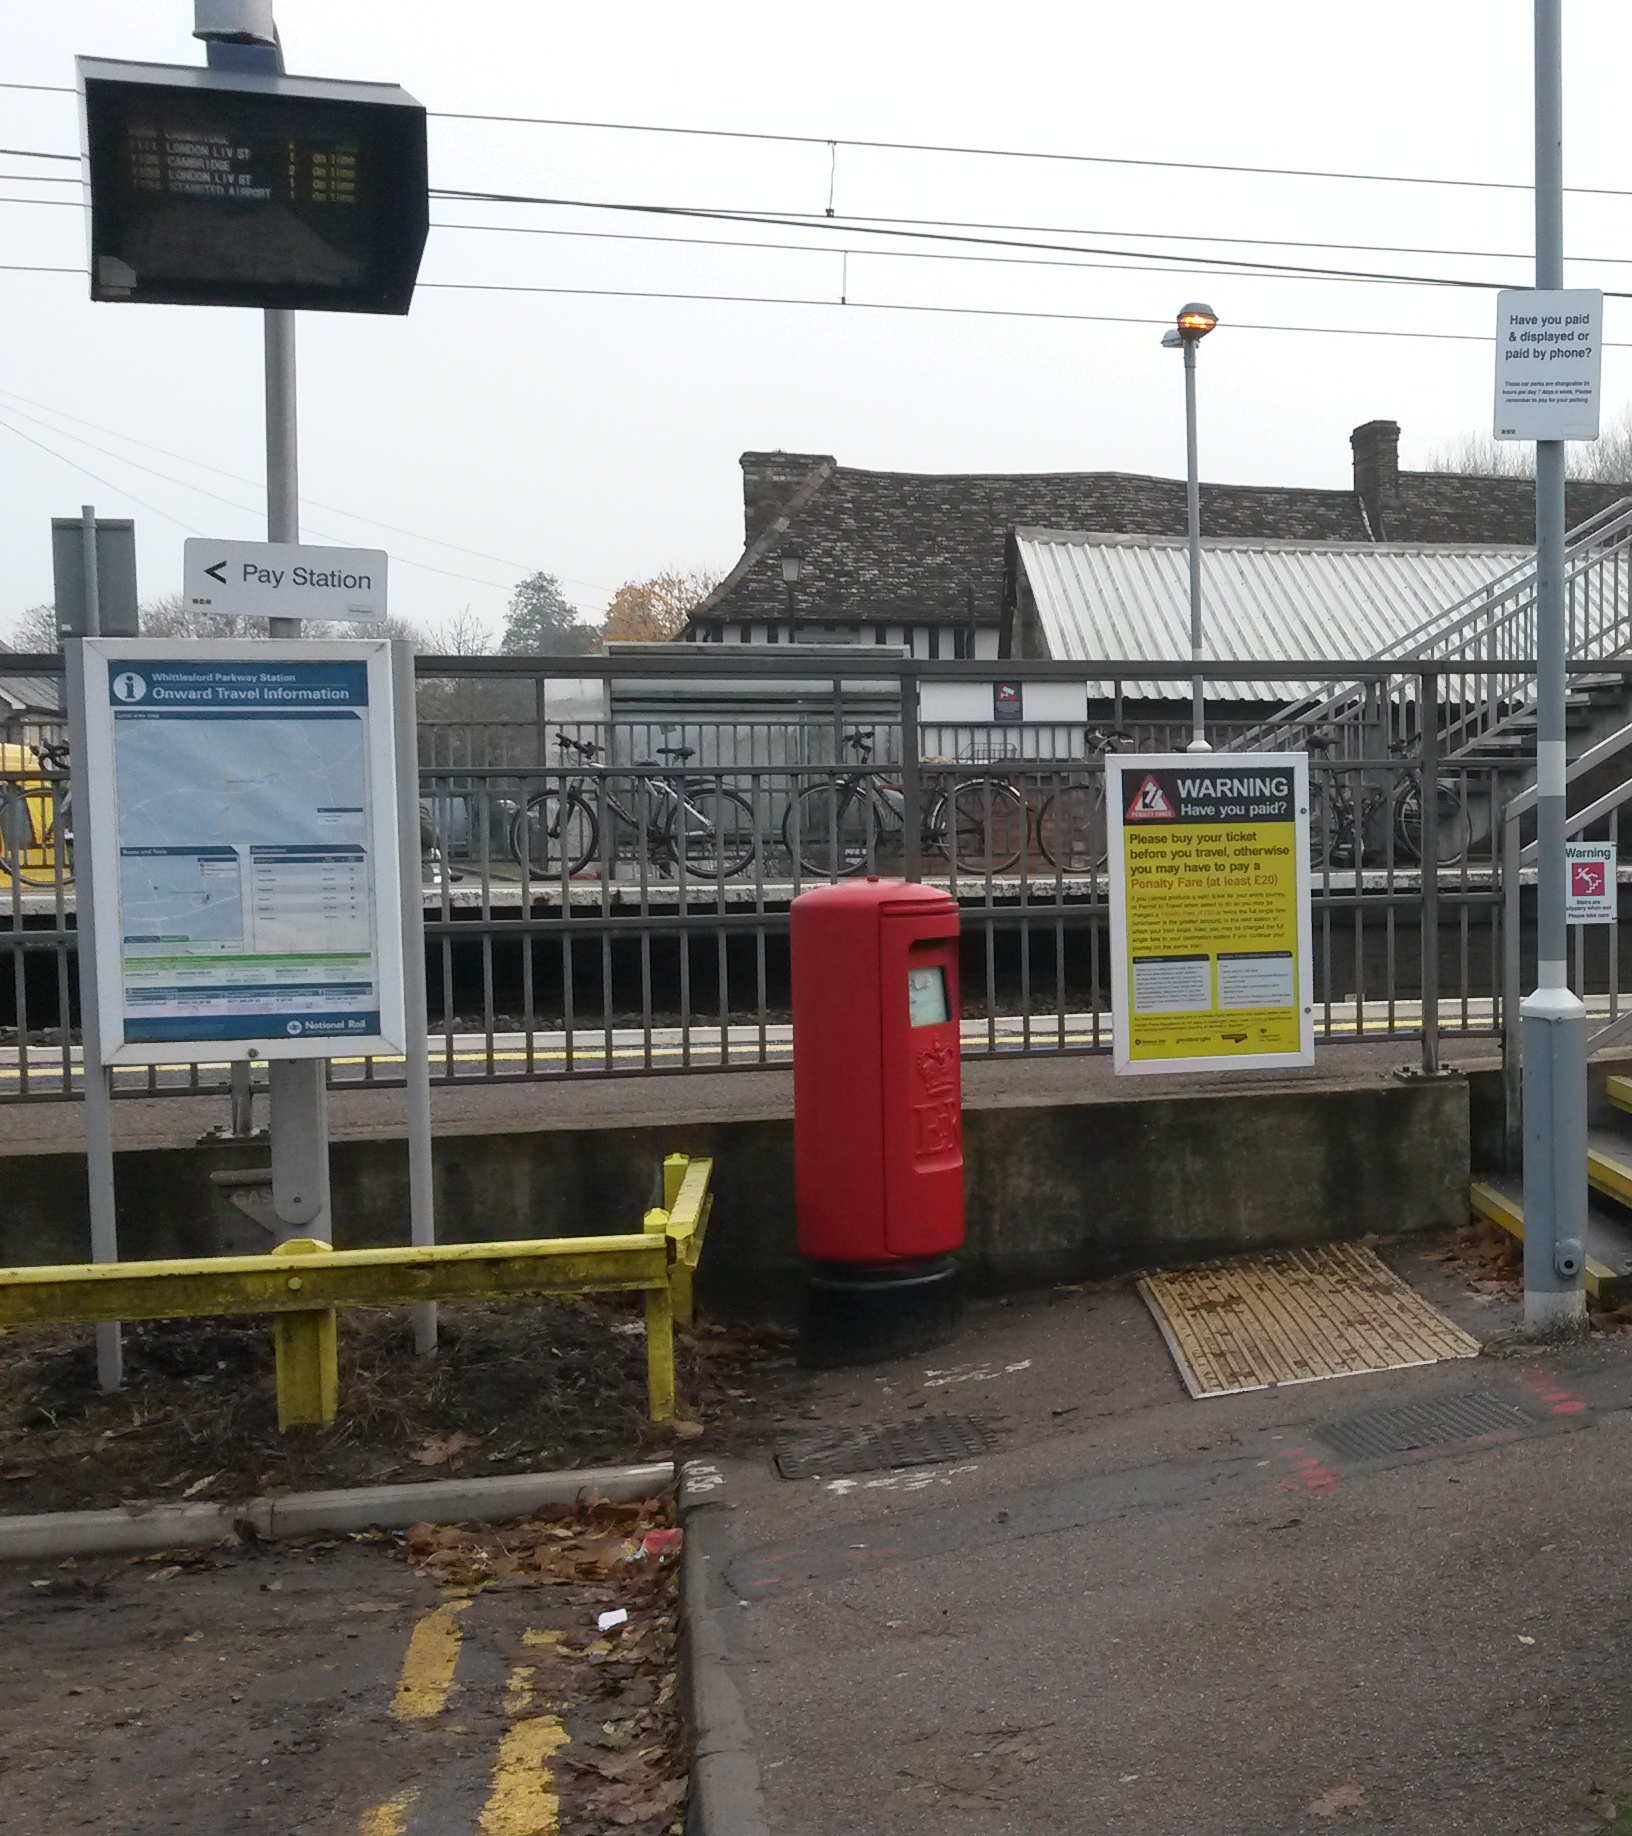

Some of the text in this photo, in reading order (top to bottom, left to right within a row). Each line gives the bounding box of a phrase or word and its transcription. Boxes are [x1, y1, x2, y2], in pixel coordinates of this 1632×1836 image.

[213, 146, 233, 158] LIV
[237, 149, 250, 159] ST
[167, 155, 231, 172] CAMBRIDGE
[169, 169, 211, 183] LONDON
[215, 173, 234, 184] LIV
[238, 174, 252, 186] ST
[1510, 314, 1590, 327] Have you paid
[1508, 332, 1590, 344] & displayed or
[1505, 348, 1592, 361] paid by phone?
[243, 564, 372, 590] Pay Station
[152, 673, 296, 684] Whittlesford Parkway Station
[152, 687, 350, 700] Onward Travel Information
[1177, 778, 1289, 798] WARNING
[1181, 802, 1287, 819] Have you paid?
[1130, 831, 1257, 845] Please buy your ticket
[1130, 845, 1290, 861] before you travel, otherwise
[1566, 848, 1611, 860] Warning
[1131, 862, 1261, 876] you may have to pay a
[1131, 874, 1278, 890] Penalty Fare (at least £20)
[305, 1019, 366, 1030] National Rail
